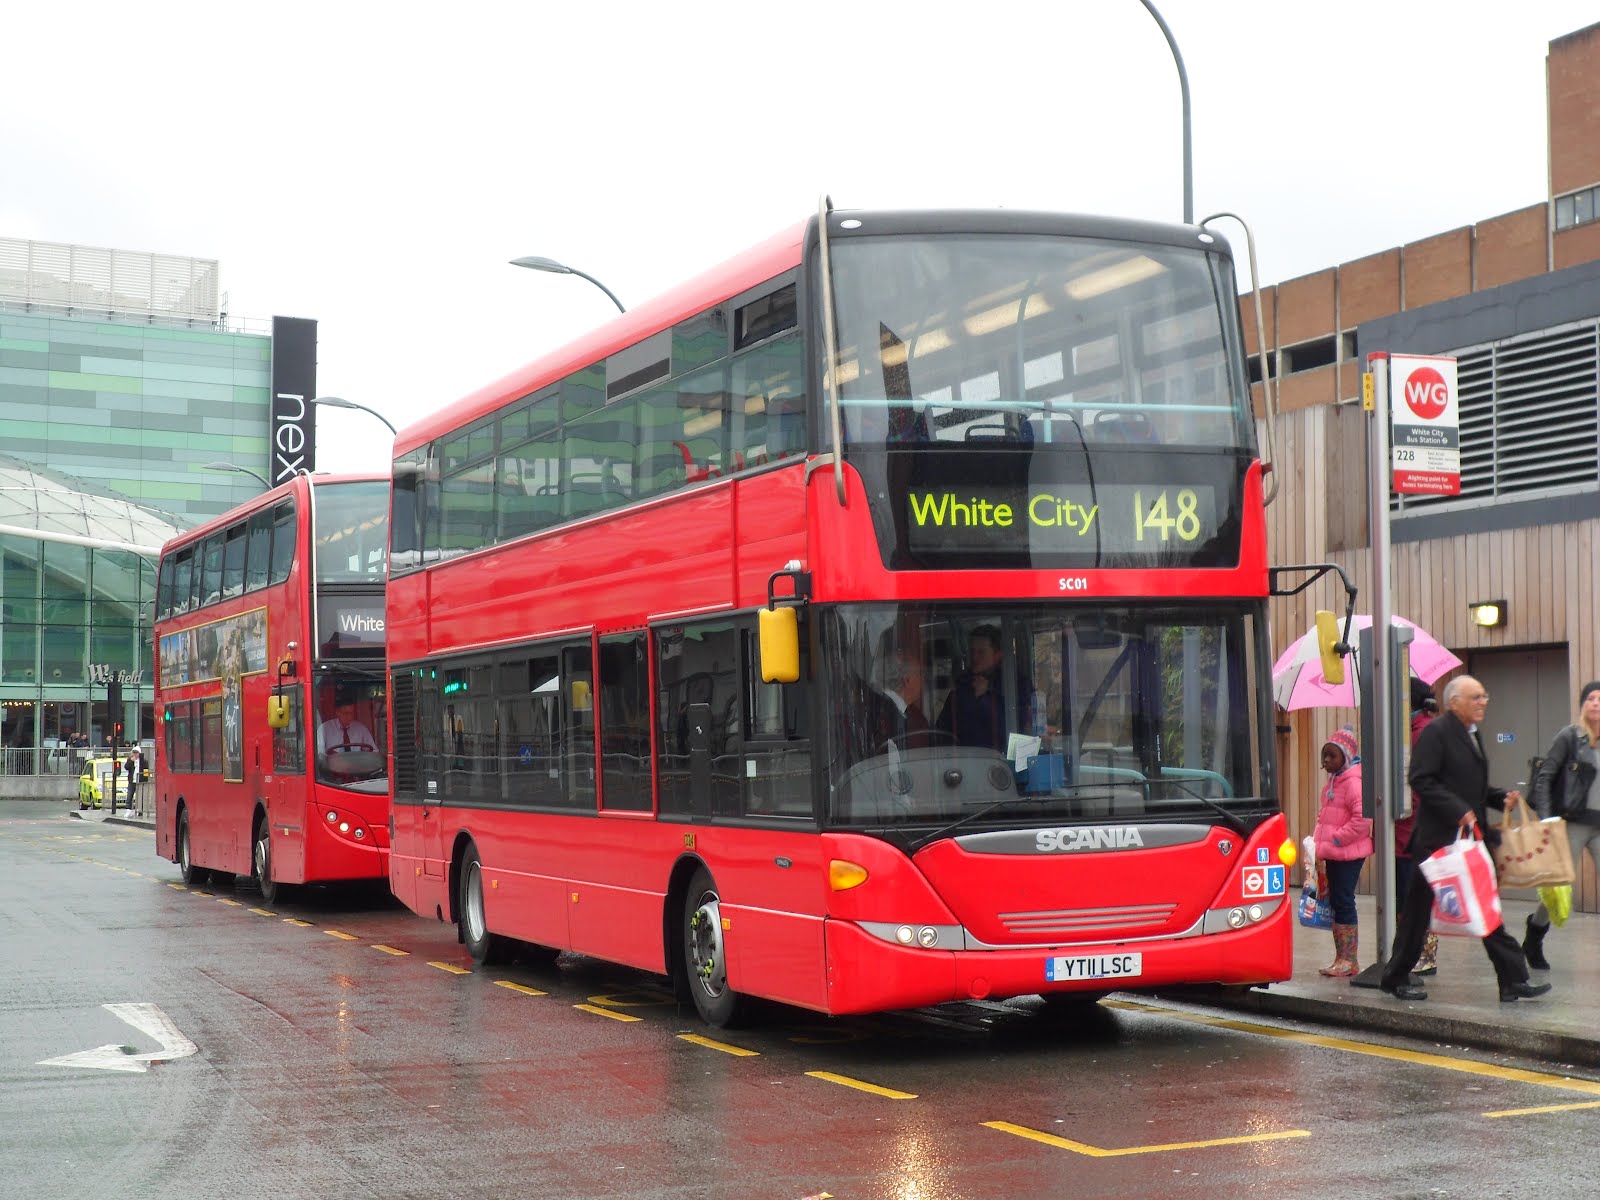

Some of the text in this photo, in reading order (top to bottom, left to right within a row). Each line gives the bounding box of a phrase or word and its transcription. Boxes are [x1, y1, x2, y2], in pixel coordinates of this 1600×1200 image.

[1407, 381, 1447, 405] WG
[1406, 435, 1441, 444] Bus Station
[1411, 428, 1444, 438] White City
[1397, 450, 1415, 461] 228
[909, 488, 1200, 541] White City 148
[1059, 578, 1088, 590] SC01
[341, 614, 385, 632] White
[88, 663, 144, 685] Wsfield
[1036, 828, 1144, 851] SCANIA
